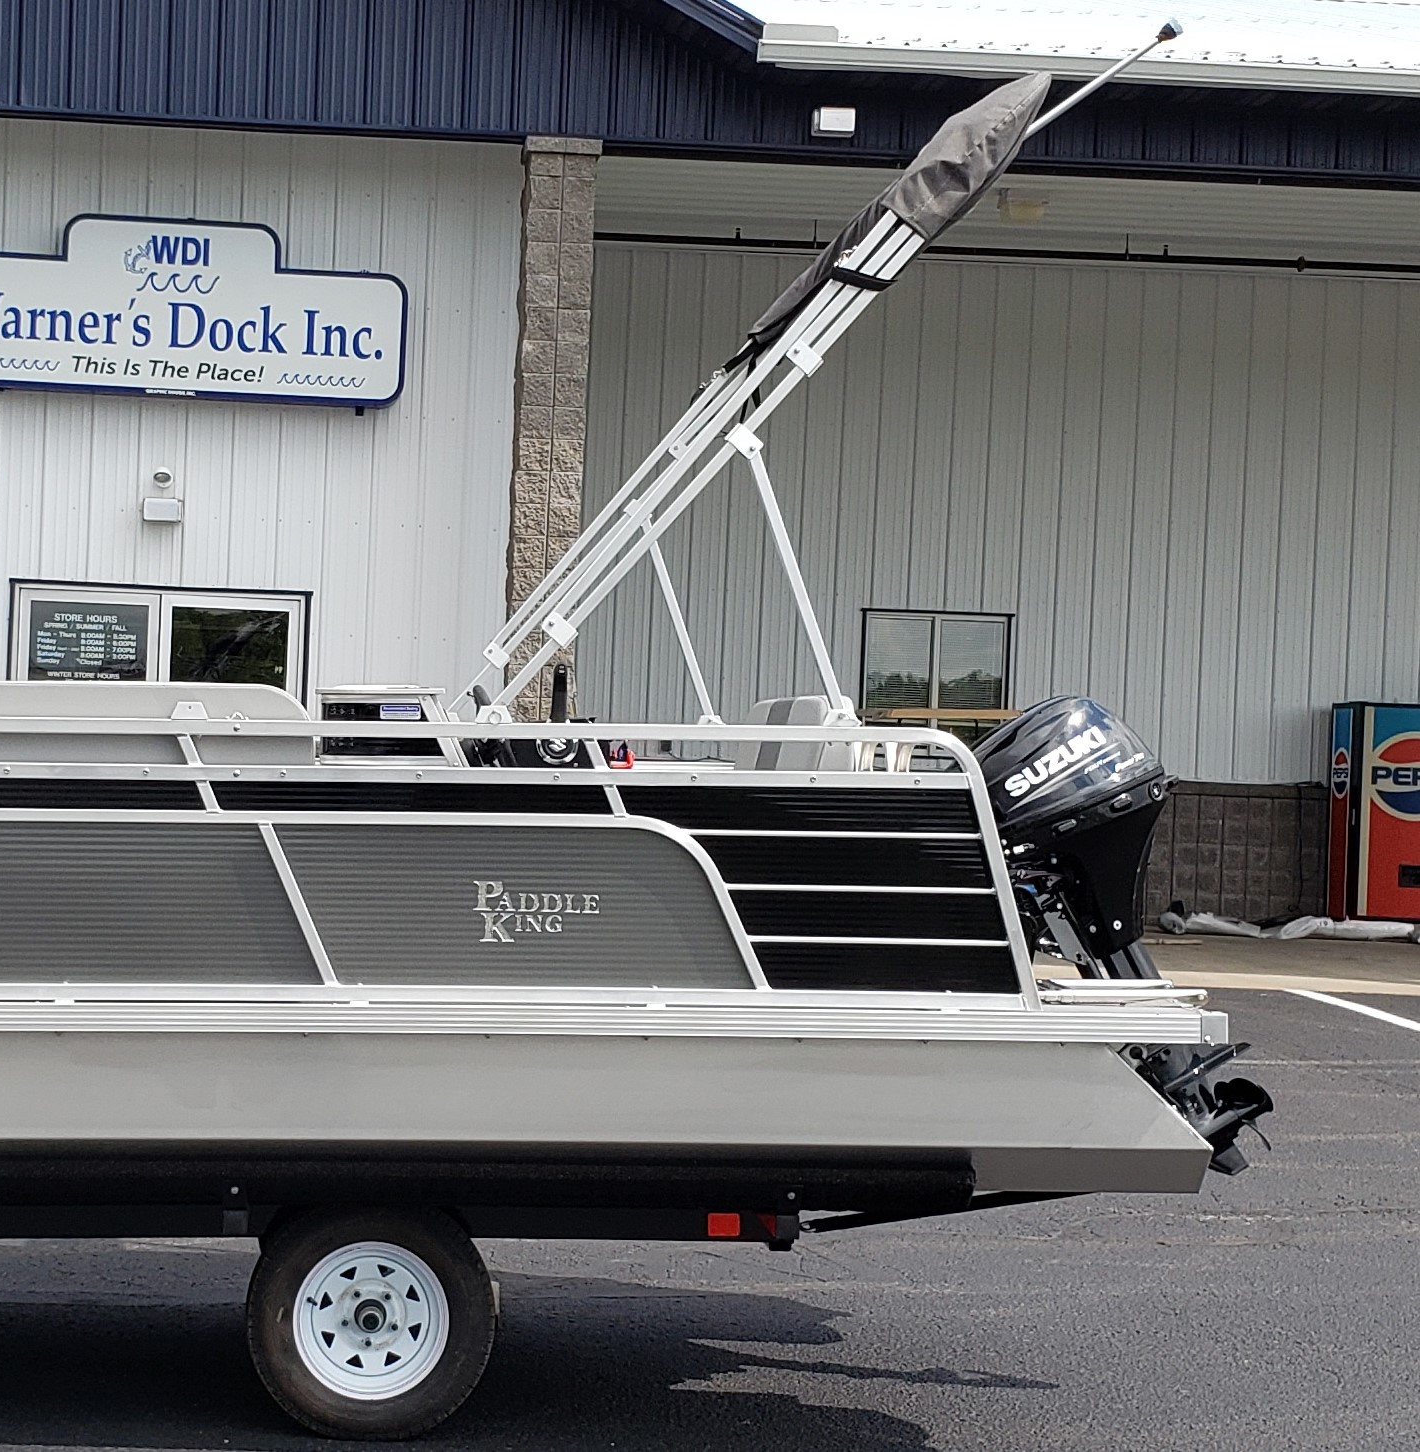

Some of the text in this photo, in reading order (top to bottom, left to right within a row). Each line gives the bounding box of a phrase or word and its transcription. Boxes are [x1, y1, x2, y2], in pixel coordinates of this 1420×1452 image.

[151, 235, 211, 267] WDI
[168, 302, 287, 354] Dock
[301, 309, 383, 360] Inc.
[72, 355, 265, 383] This Is The Place!
[53, 613, 118, 623] STORE HOURS
[75, 623, 104, 631] SUMMER
[1004, 726, 1107, 798] SUZUKI
